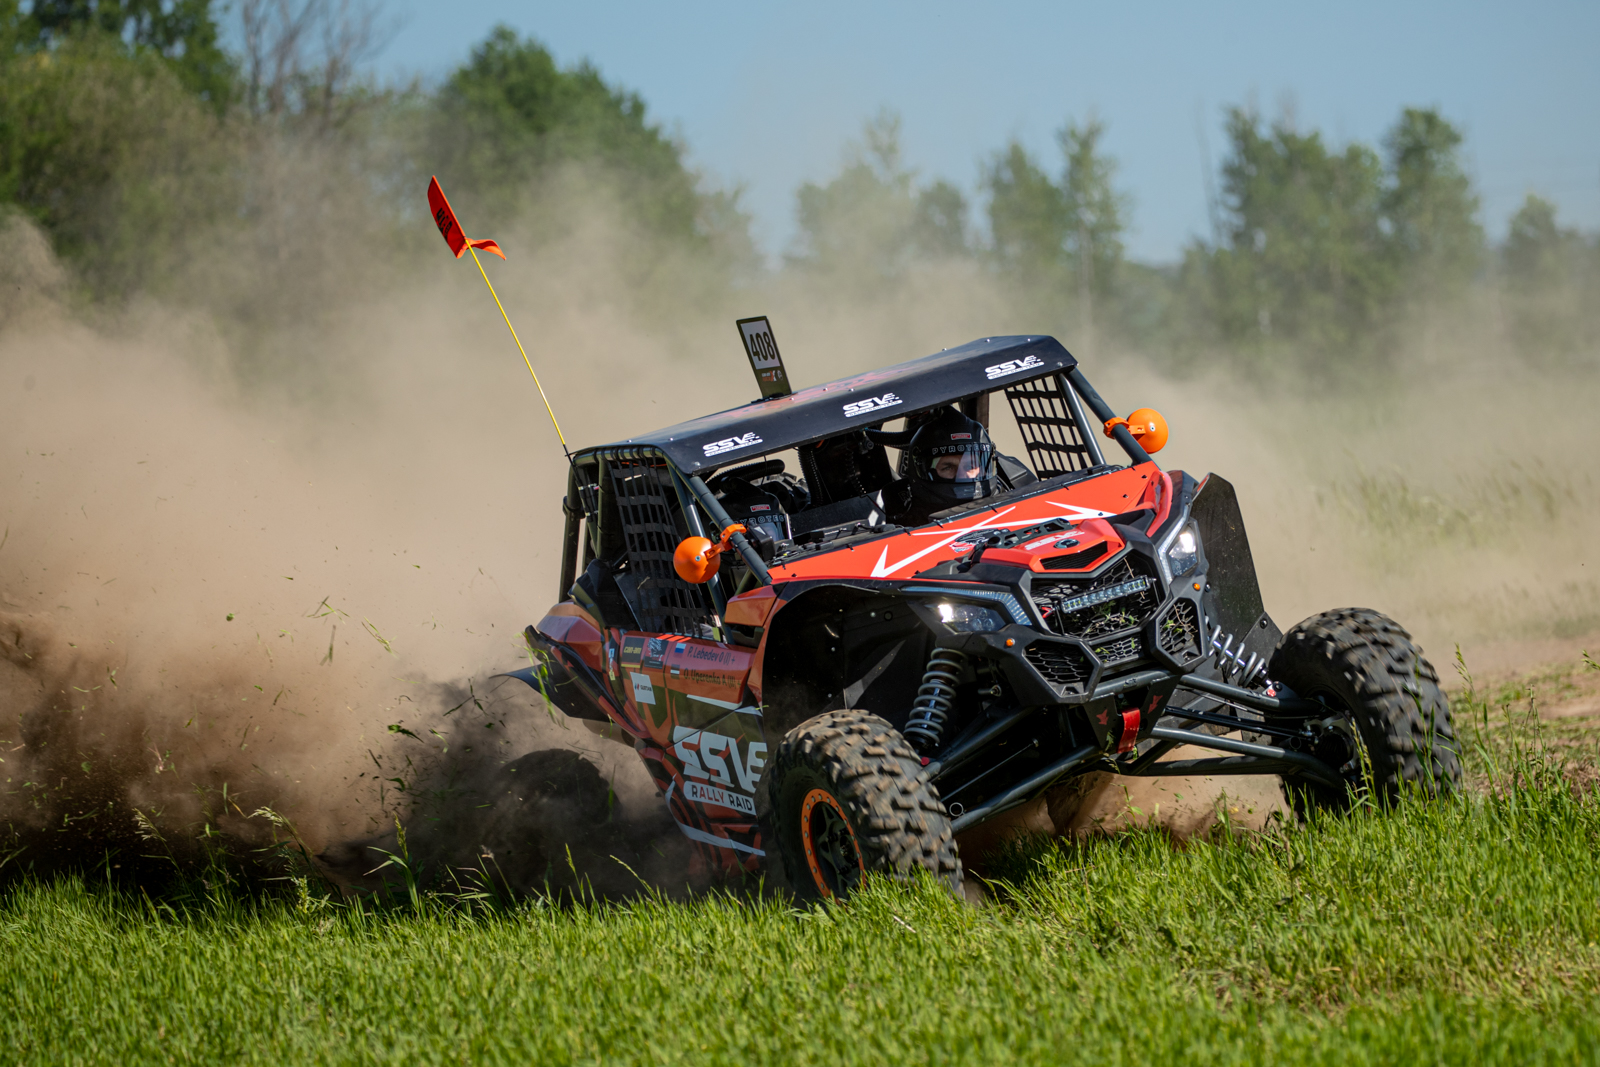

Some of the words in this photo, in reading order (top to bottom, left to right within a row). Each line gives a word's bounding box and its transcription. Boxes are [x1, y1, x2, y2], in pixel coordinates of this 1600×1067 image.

[750, 331, 775, 361] 408
[693, 647, 719, 661] Lebedev
[691, 785, 725, 804] RALLY
[728, 794, 753, 811] RAID
